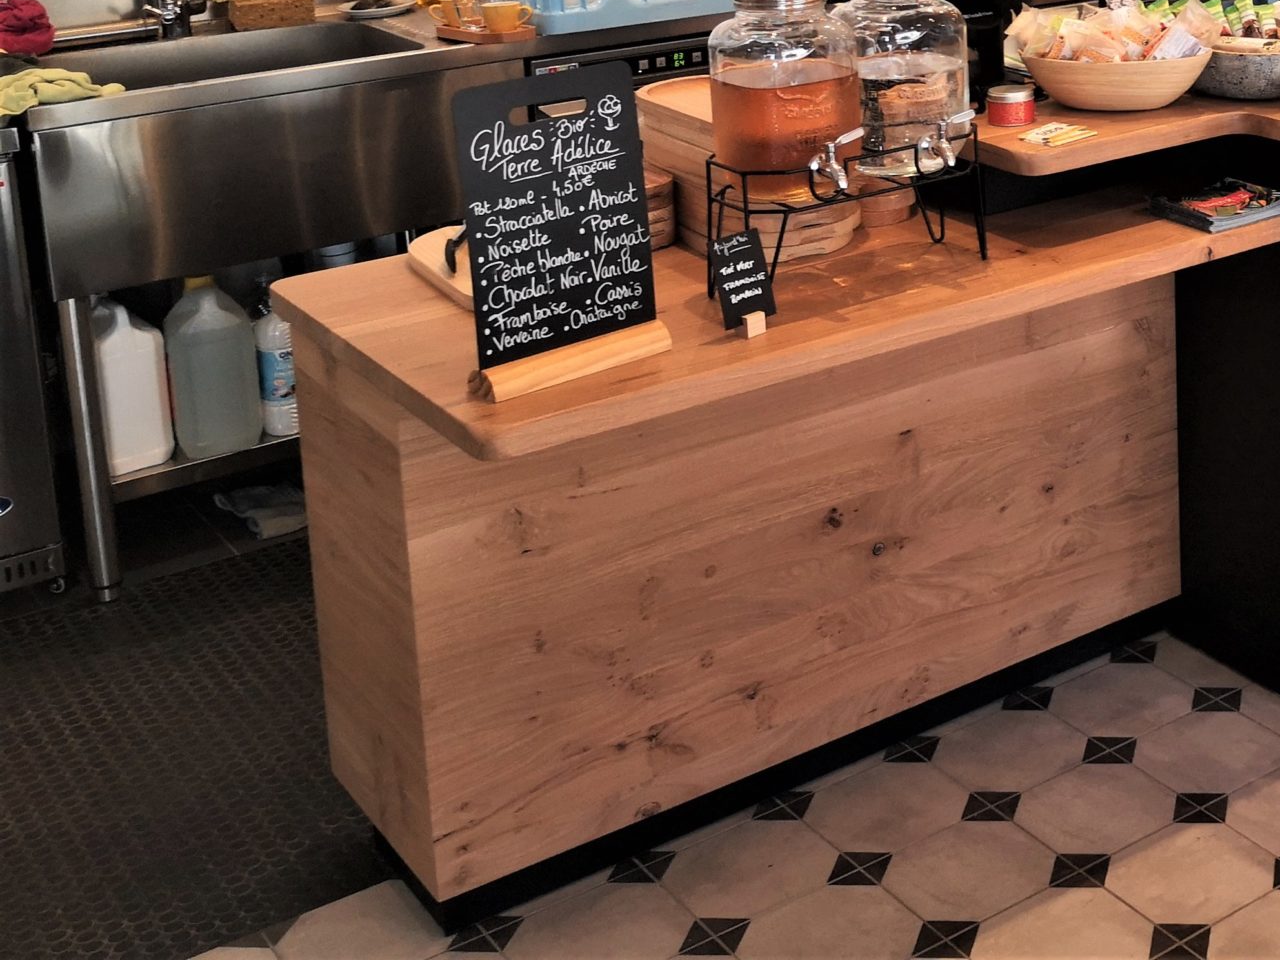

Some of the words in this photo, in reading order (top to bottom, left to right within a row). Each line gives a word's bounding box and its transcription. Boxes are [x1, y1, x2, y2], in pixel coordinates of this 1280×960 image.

[674, 59, 685, 68] 64
[470, 120, 545, 171] Glaces
[556, 117, 588, 139] Bio
[487, 155, 542, 181] Terre
[550, 133, 620, 172] Adélice
[469, 200, 491, 216] Pot
[484, 198, 575, 239] Stracciatella
[588, 182, 639, 211] Abricot
[480, 258, 536, 283] Pêche
[537, 247, 584, 272] blanche
[594, 224, 650, 256] Nougat
[488, 229, 552, 261] Noisette
[581, 213, 634, 232] Poire
[489, 273, 556, 309] Chocolat
[560, 265, 588, 290] Noir
[591, 251, 648, 282] Vanille
[488, 300, 571, 332] Framboise
[595, 281, 642, 305] Cassis
[493, 325, 554, 351] Verveine
